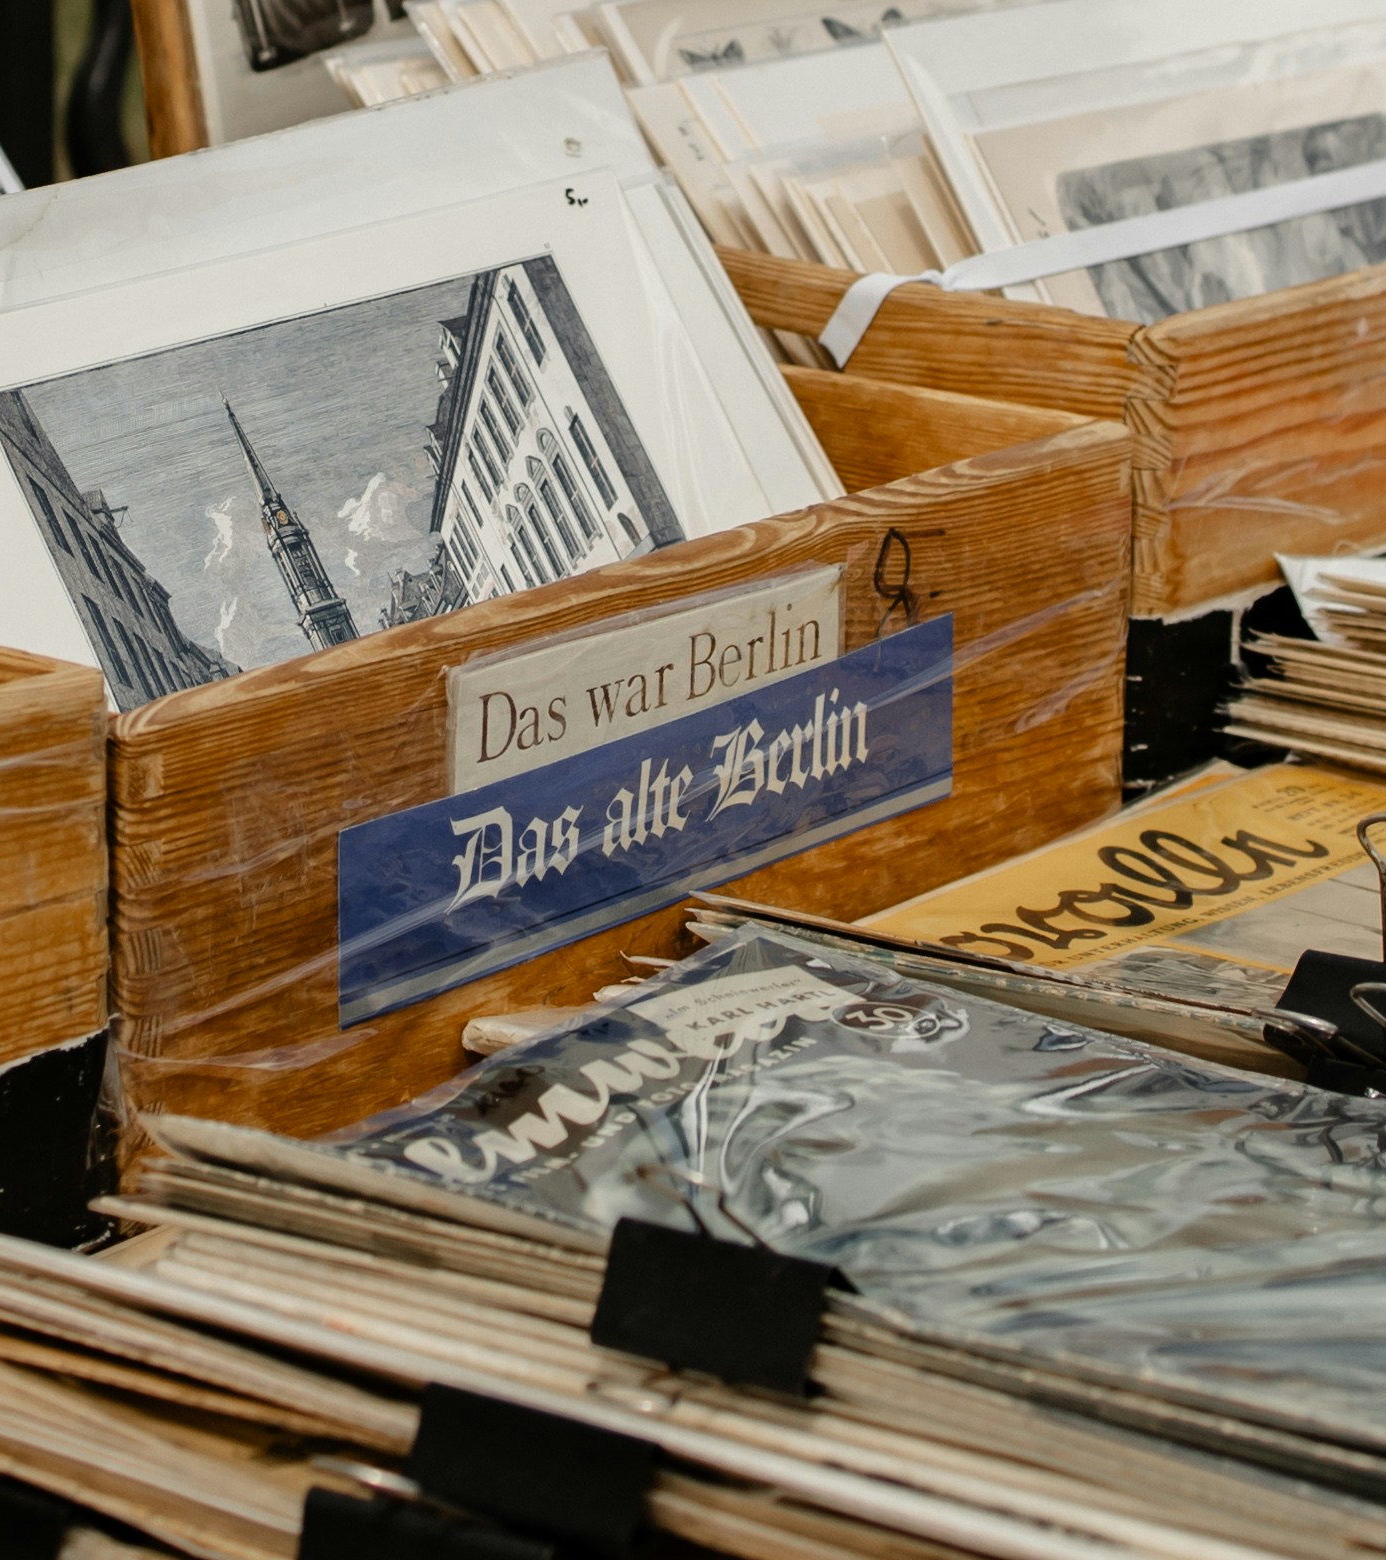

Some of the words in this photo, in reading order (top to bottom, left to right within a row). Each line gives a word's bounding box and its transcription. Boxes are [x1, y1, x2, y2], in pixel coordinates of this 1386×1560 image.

[476, 690, 567, 764] Das
[586, 660, 674, 729] war
[686, 602, 823, 701] Berlin
[443, 803, 584, 916] Das
[601, 756, 694, 858] alte
[705, 686, 870, 822] Berlin
[1067, 915, 1206, 964] UNTERHALTUNG,
[685, 1006, 755, 1032] KARL
[755, 987, 838, 1011] HARTL
[845, 1007, 913, 1030] 30
[580, 1111, 638, 1150] UND
